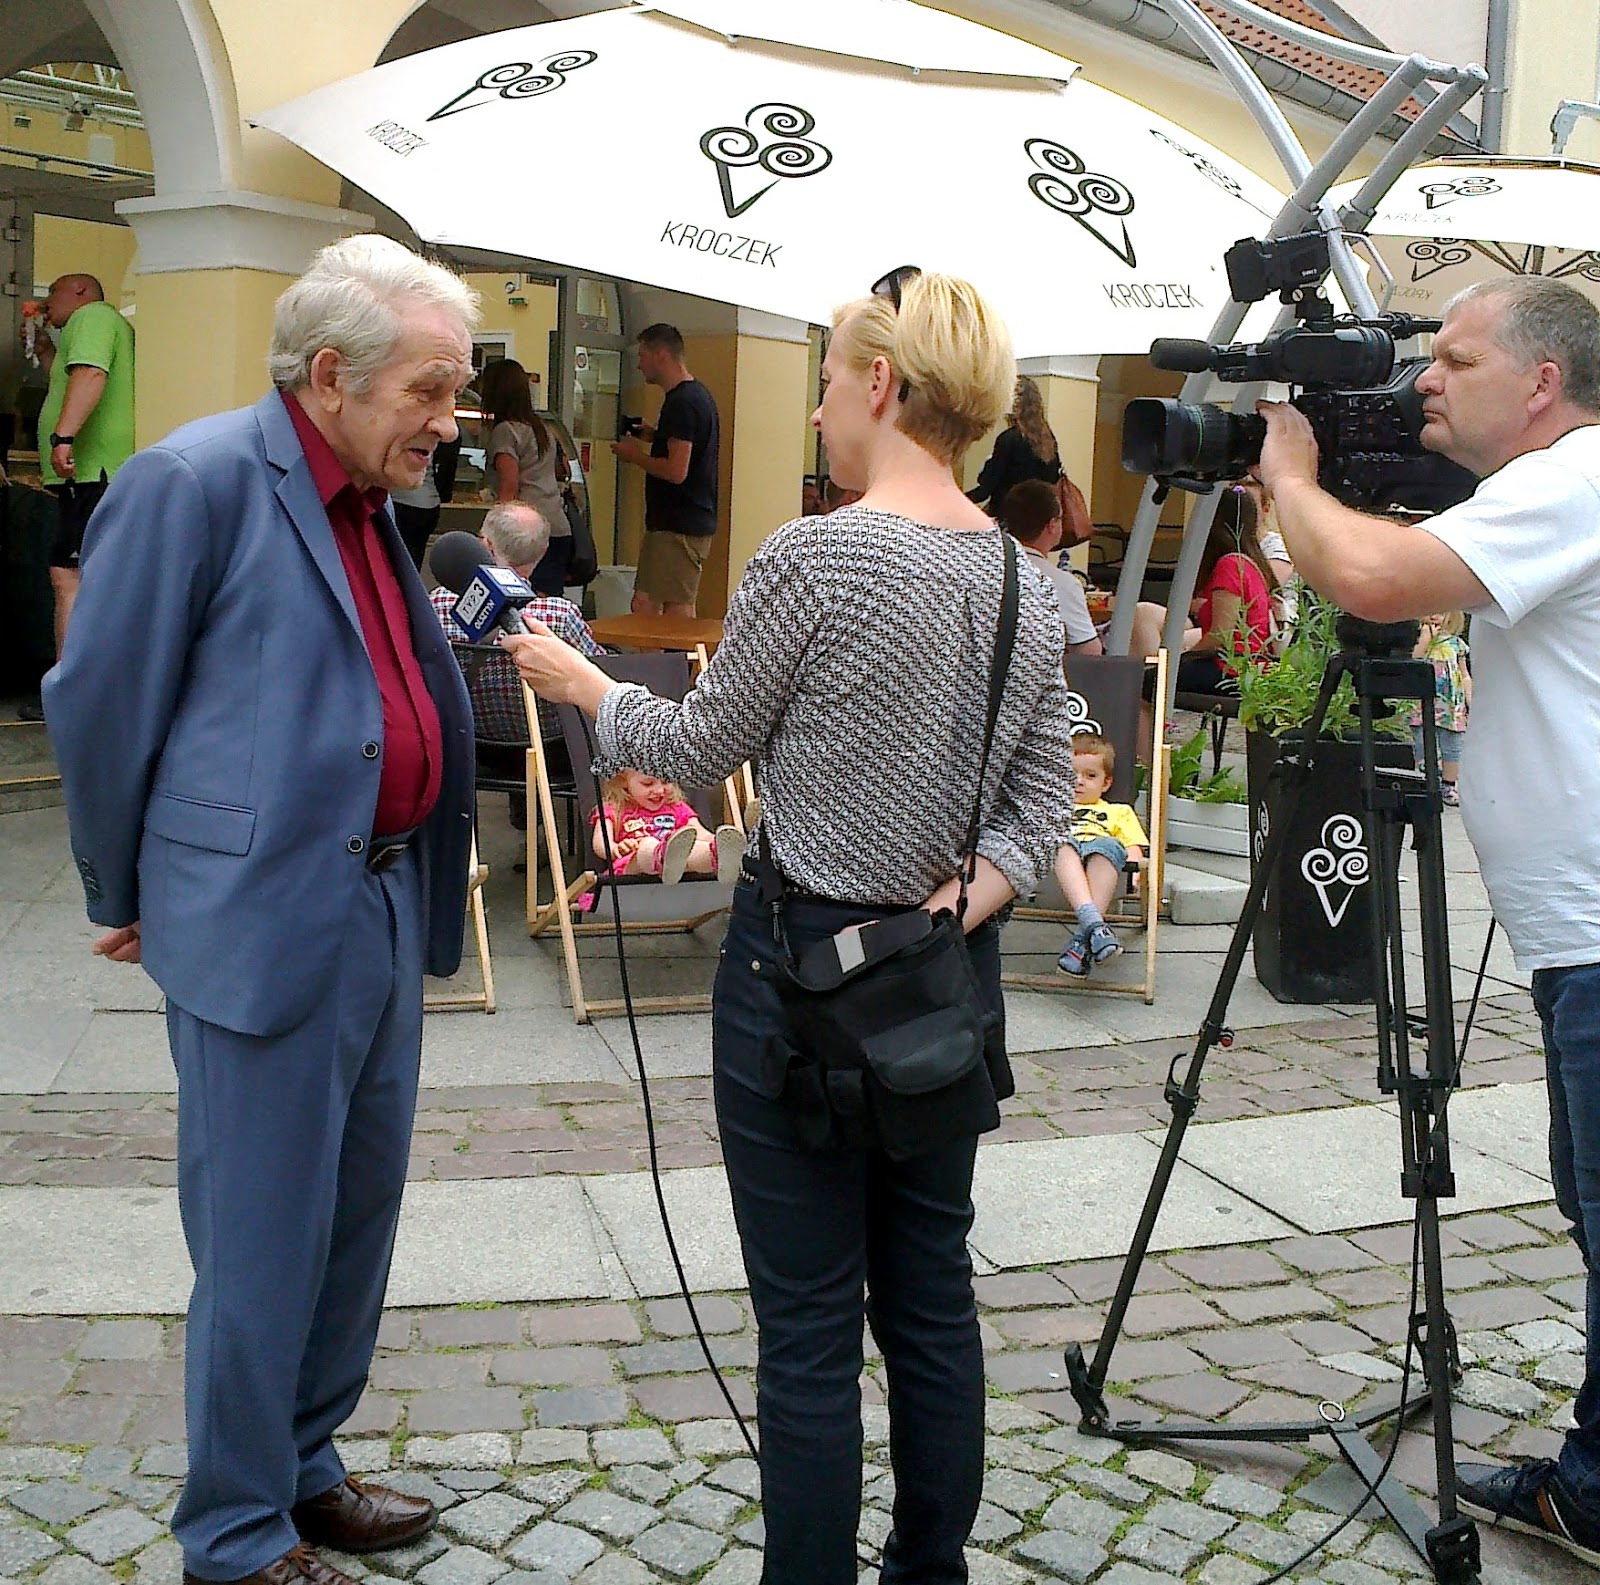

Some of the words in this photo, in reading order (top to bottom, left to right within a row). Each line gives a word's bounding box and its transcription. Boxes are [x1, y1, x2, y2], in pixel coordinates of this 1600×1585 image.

[365, 119, 430, 157] KROCZEK
[660, 220, 783, 268] KROCZEK
[1102, 283, 1204, 308] KROCZEK
